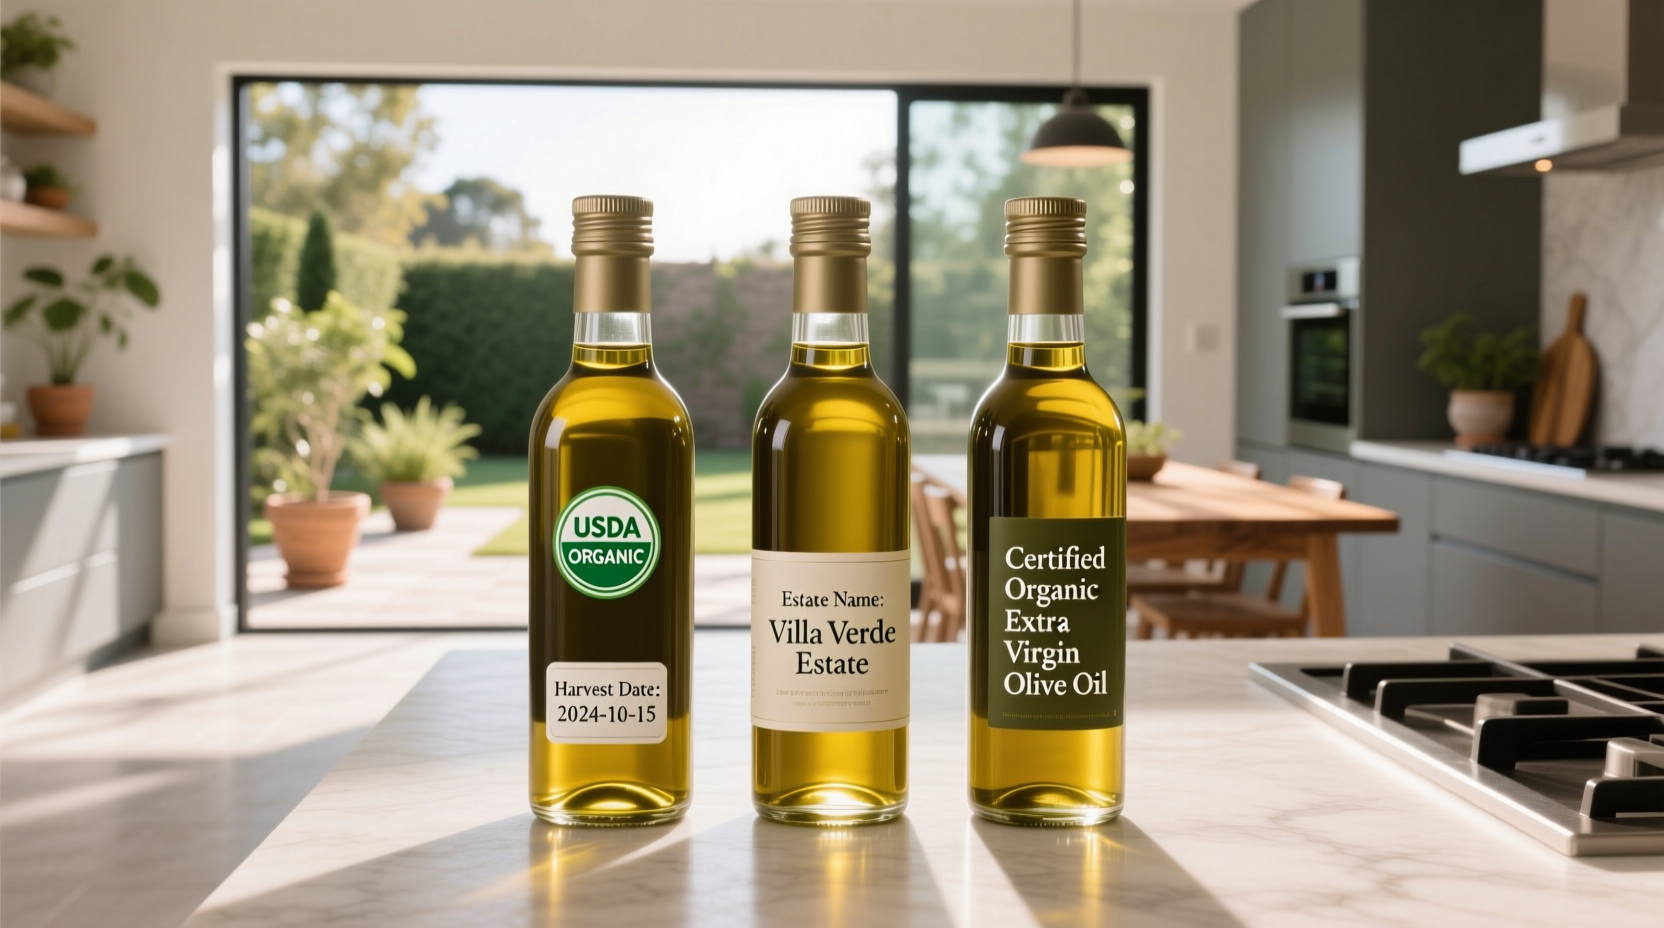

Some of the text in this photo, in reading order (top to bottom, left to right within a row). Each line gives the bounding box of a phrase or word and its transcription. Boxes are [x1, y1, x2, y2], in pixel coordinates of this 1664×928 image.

[573, 516, 642, 539] USDA
[568, 548, 645, 565] ORGANIC
[1005, 545, 1106, 570] Certified
[781, 590, 884, 608] Estate Name:
[1004, 576, 1099, 608] Organic
[769, 618, 896, 645] Villa Verde
[1004, 608, 1071, 634] Extra
[795, 651, 869, 675] Estate
[1003, 639, 1081, 671] Virgin
[554, 681, 661, 698] Harvest Date:
[1003, 669, 1108, 696] Olive Oil
[557, 704, 657, 723] 2024-10-15
